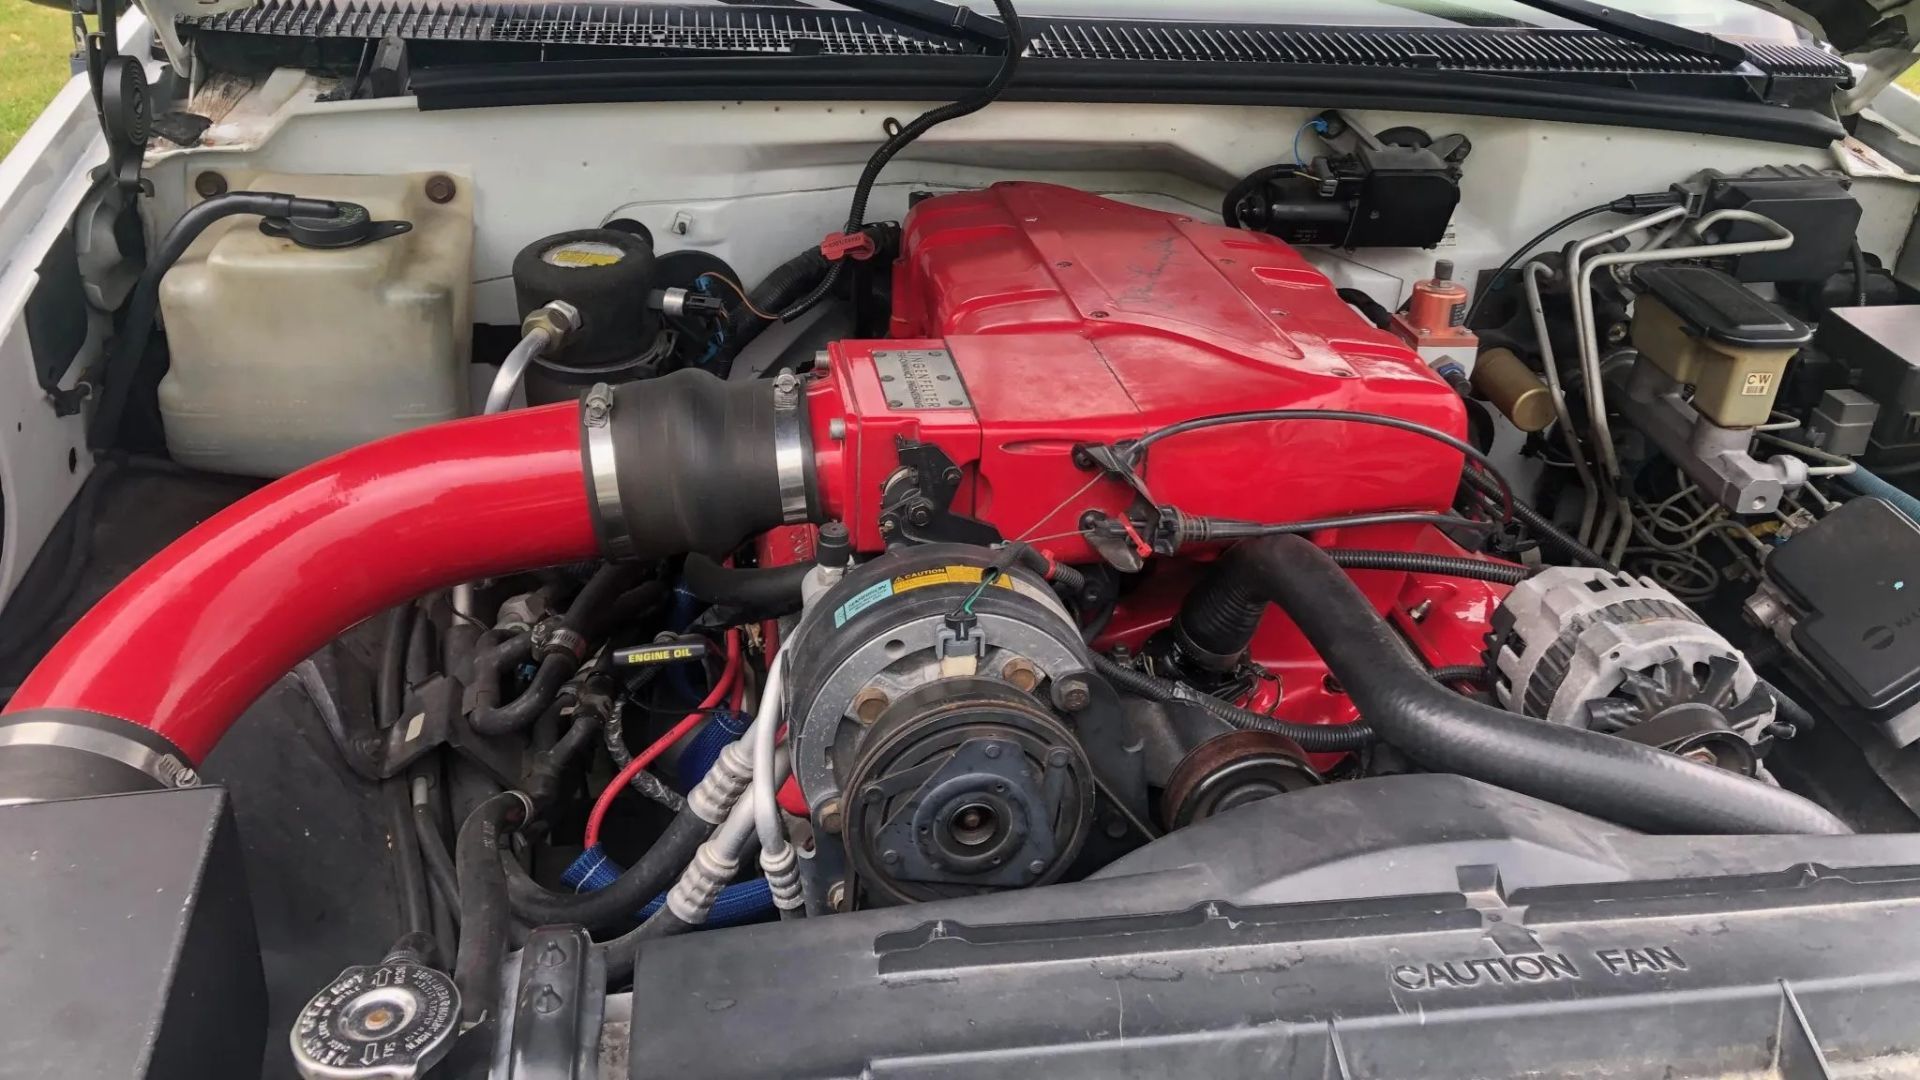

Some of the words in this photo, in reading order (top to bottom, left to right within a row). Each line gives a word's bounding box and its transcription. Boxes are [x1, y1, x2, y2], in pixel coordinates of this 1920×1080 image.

[1747, 374, 1771, 385] CW
[904, 568, 945, 580] CAUTION
[628, 650, 670, 663] ENGINE
[673, 648, 692, 658] OIL
[1393, 953, 1580, 990] CAUTION
[1596, 946, 1688, 975] FAN
